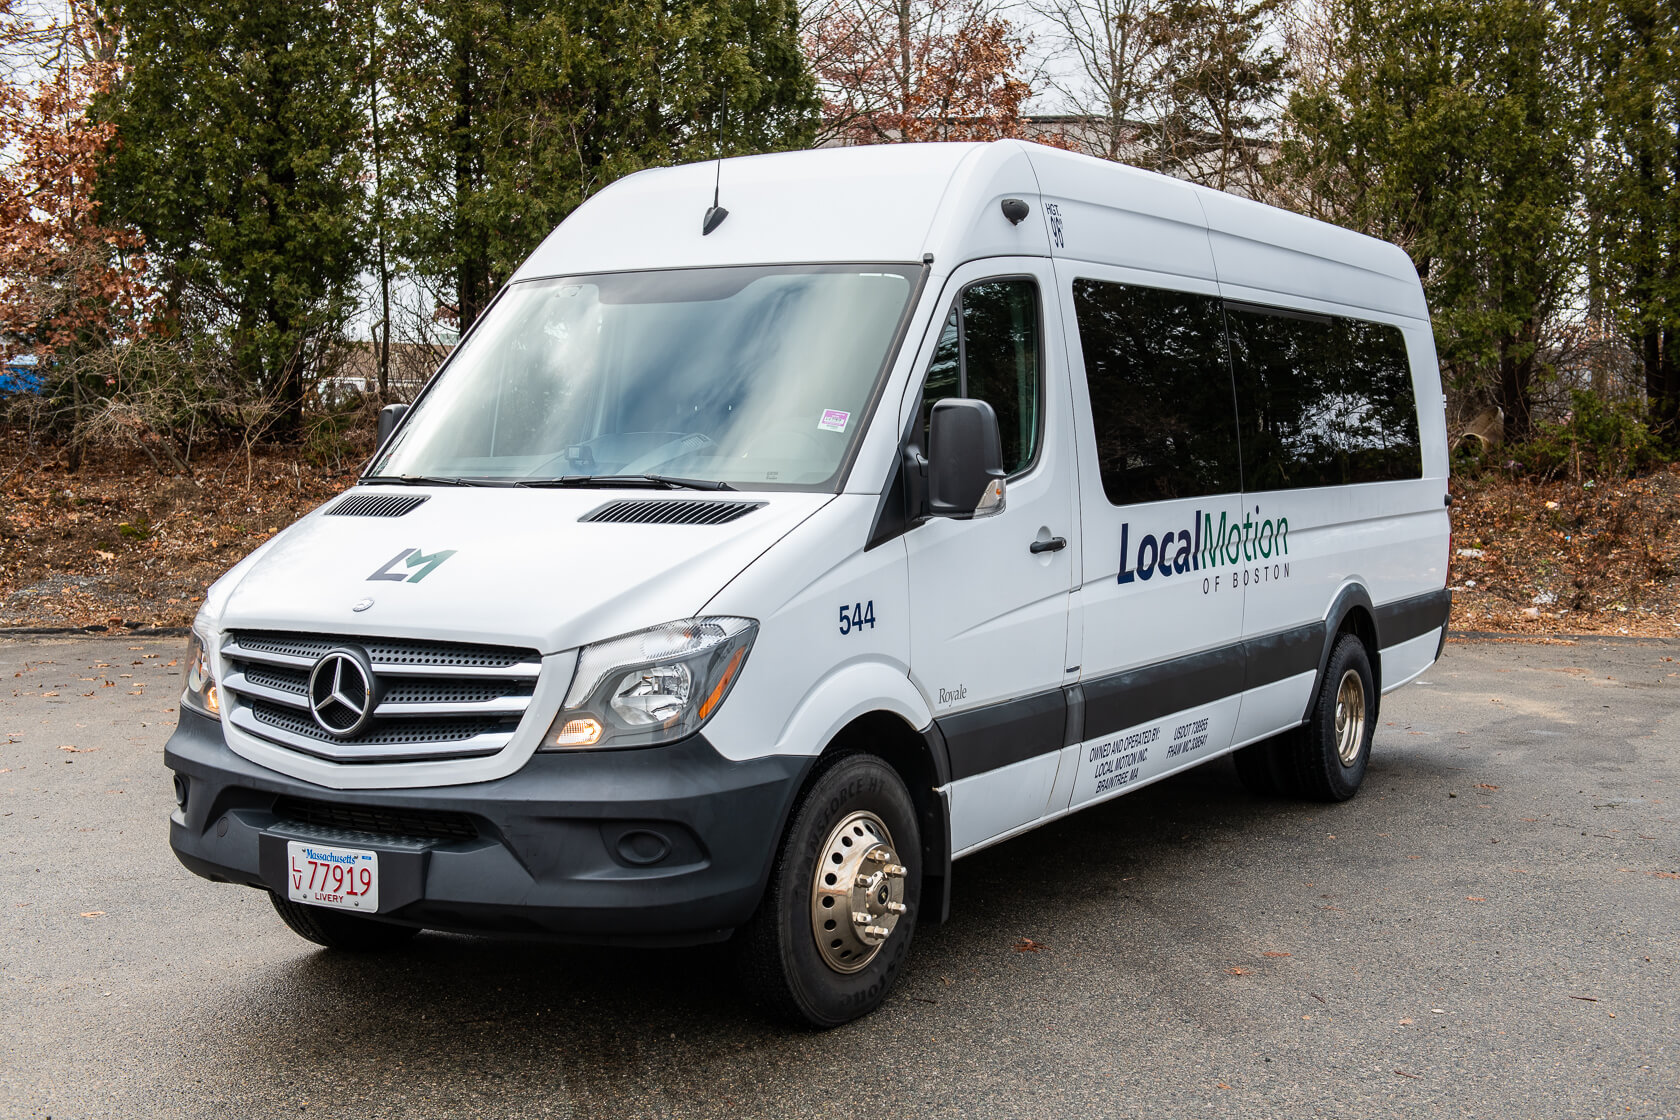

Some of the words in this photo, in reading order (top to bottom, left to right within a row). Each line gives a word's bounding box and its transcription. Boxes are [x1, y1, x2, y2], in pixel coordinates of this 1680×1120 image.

[1202, 575, 1220, 595] OF
[1233, 562, 1290, 588] BOSTON
[839, 600, 876, 635] 544
[938, 684, 967, 707] Royale
[1173, 722, 1193, 741] USDOT
[1089, 743, 1112, 762] OWNED
[1110, 738, 1124, 755] AND
[1123, 728, 1153, 752] OPERATED
[1094, 758, 1115, 778] LOCAL
[1113, 750, 1138, 771] MOTION
[1127, 767, 1139, 781] MA
[306, 848, 356, 865] Massachusetts
[308, 860, 372, 897] 77919
[315, 892, 344, 904] LIVERY
